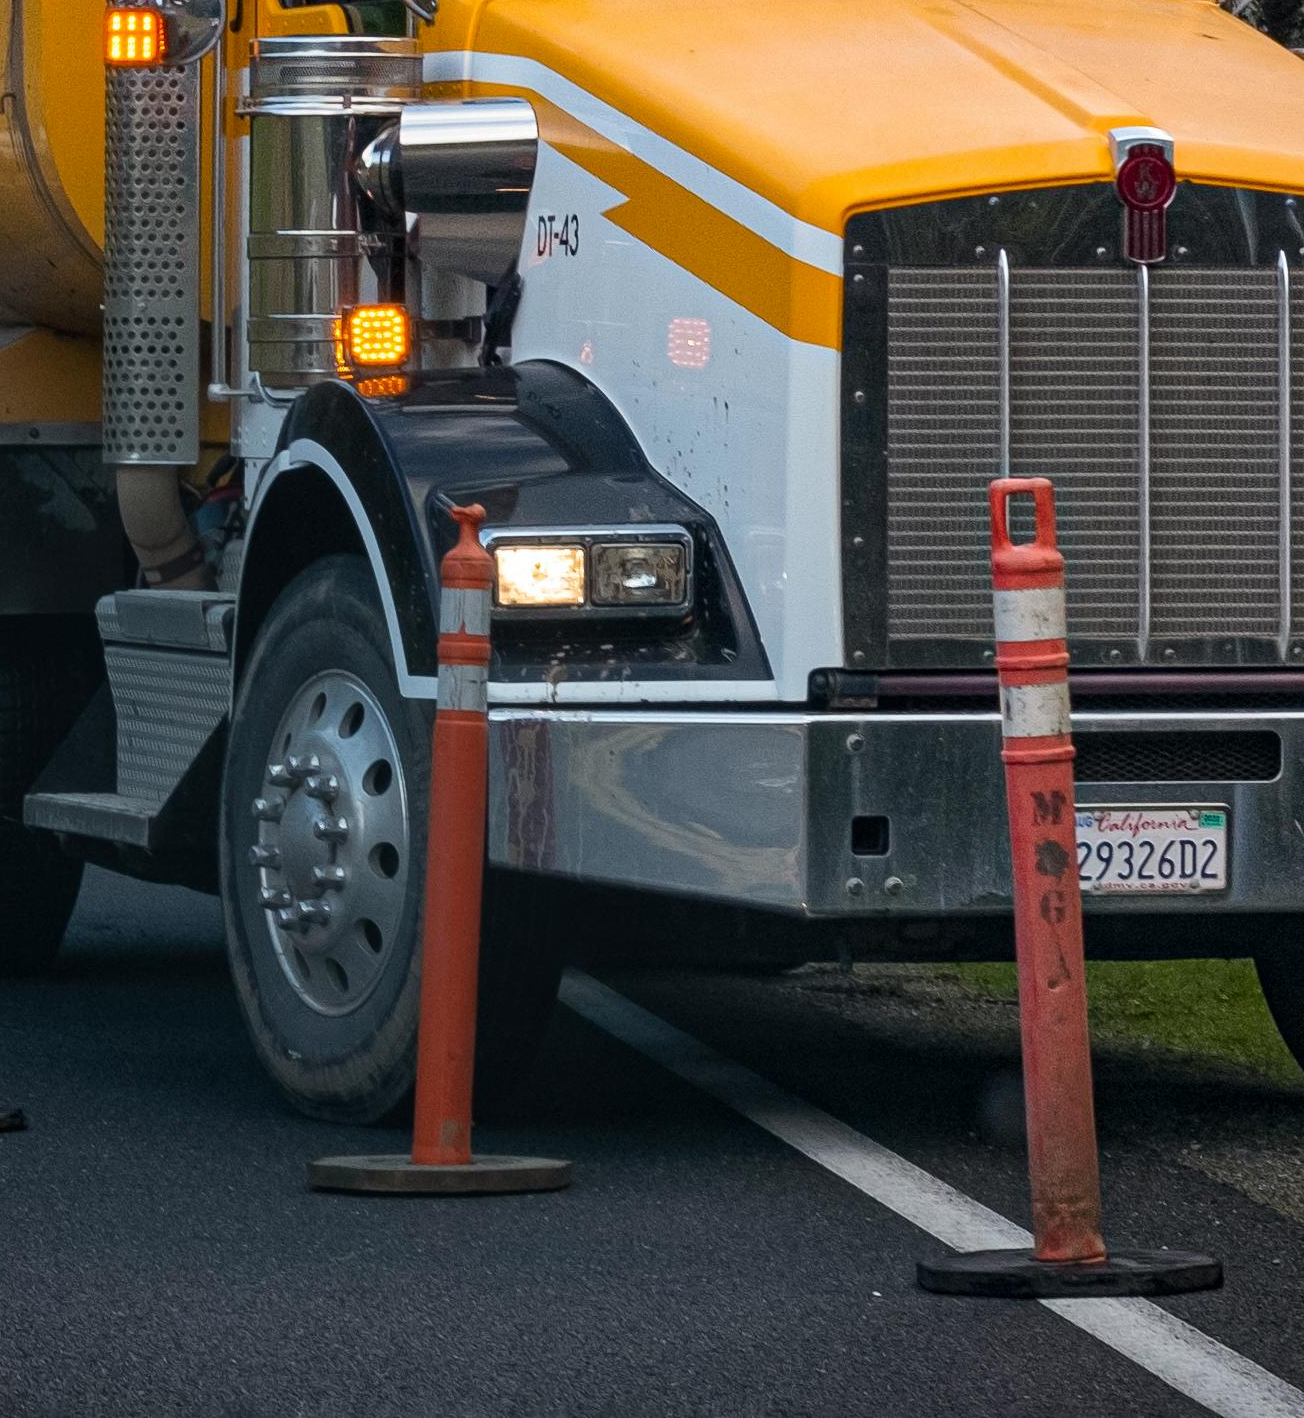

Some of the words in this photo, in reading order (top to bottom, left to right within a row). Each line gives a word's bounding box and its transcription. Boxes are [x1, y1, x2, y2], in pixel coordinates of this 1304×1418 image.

[537, 214, 579, 257] DT-43
[1097, 812, 1198, 837] California
[1078, 839, 1218, 880] 29326D2
